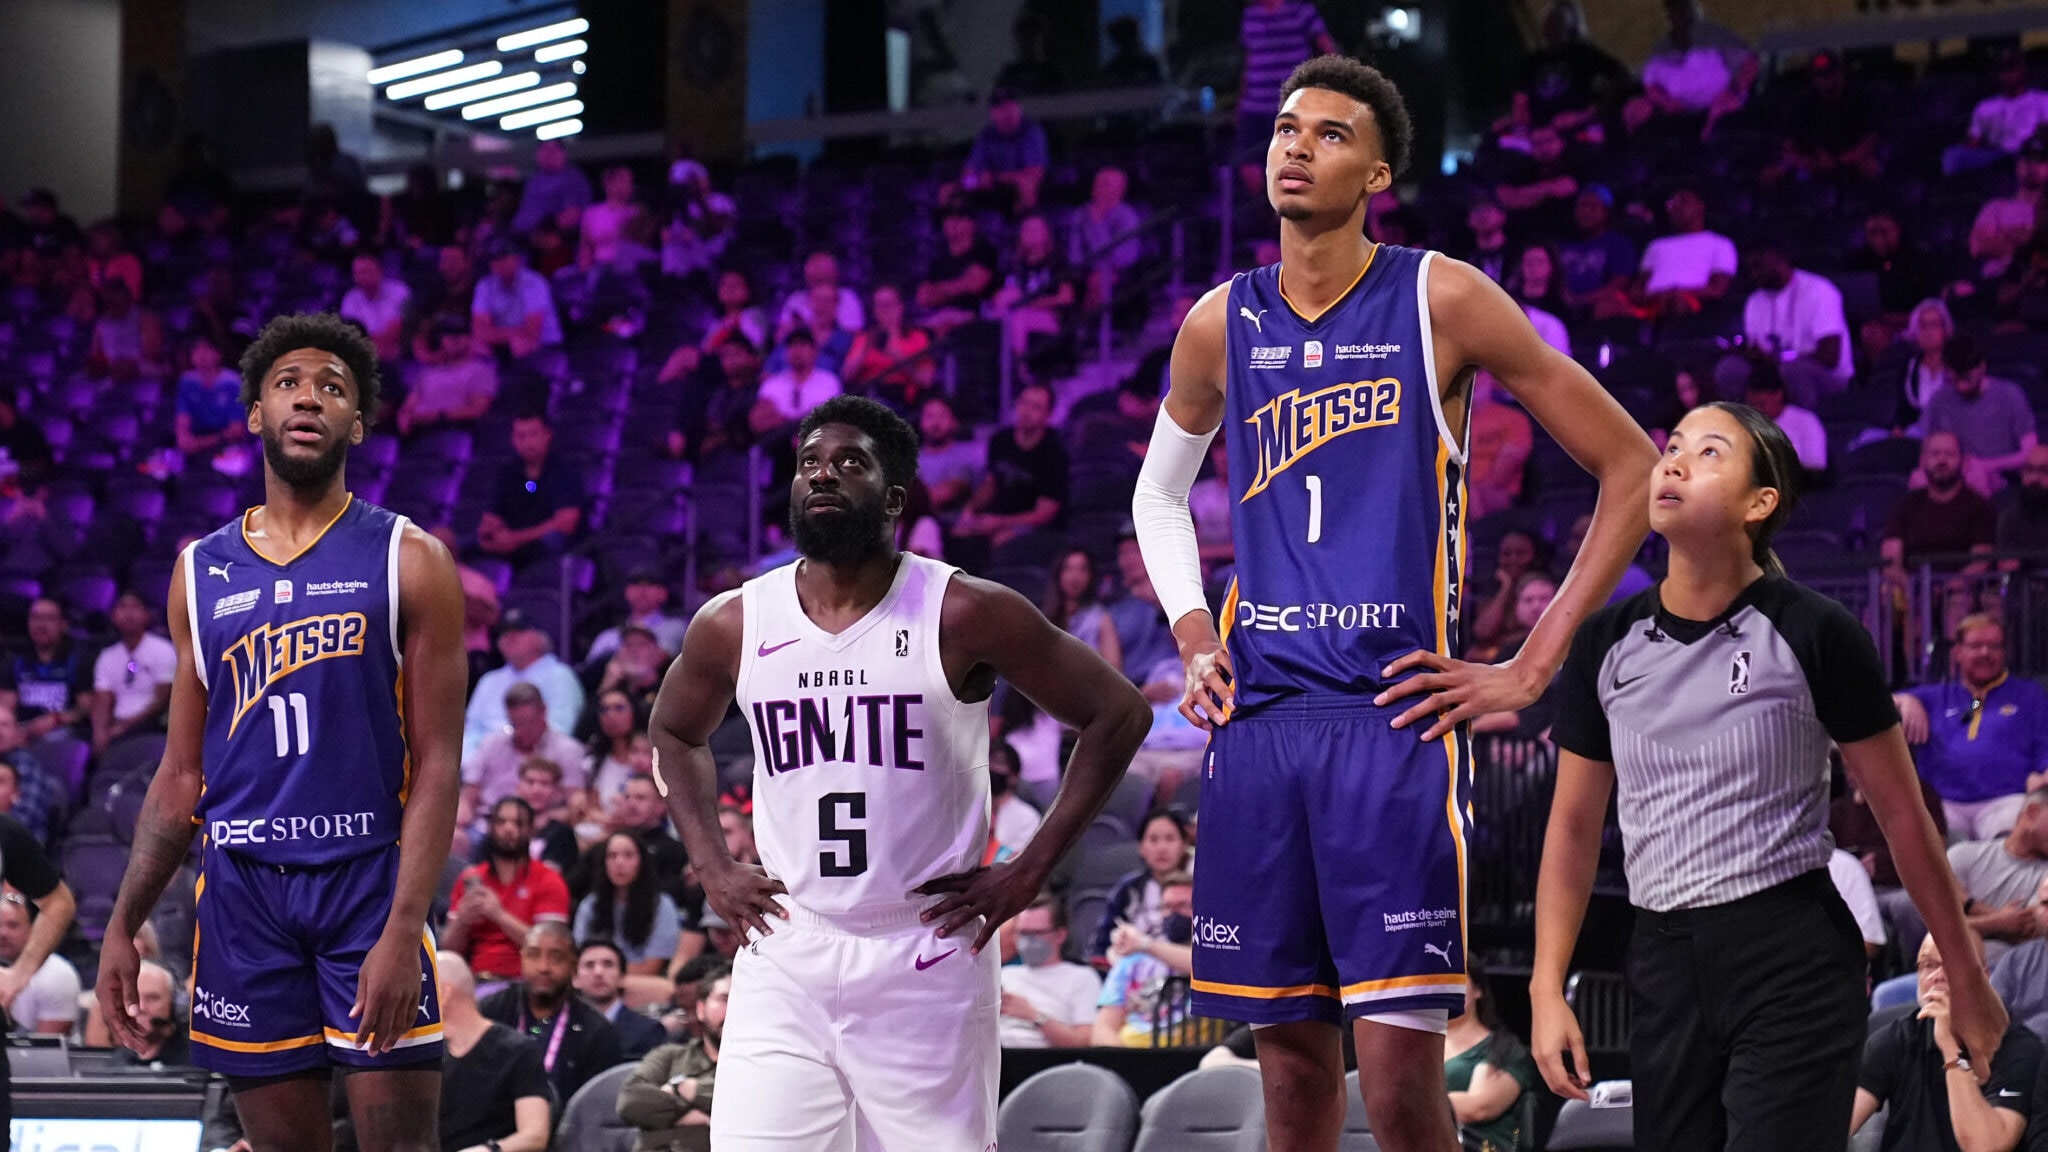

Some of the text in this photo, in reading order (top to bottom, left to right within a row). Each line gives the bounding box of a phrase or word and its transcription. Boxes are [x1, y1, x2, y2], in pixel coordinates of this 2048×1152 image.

[1335, 343, 1401, 354] hauts-de-seine
[1305, 475, 1322, 543] 1
[1305, 603, 1406, 630] SPORT
[798, 669, 868, 689] NBAGL
[268, 692, 309, 758] 11
[752, 694, 925, 777] IGNITE
[271, 812, 375, 841] SPORT
[818, 792, 868, 878] 5
[1200, 915, 1240, 944] idex
[1383, 907, 1457, 925] hauts-de-seine
[211, 993, 250, 1022] idex
